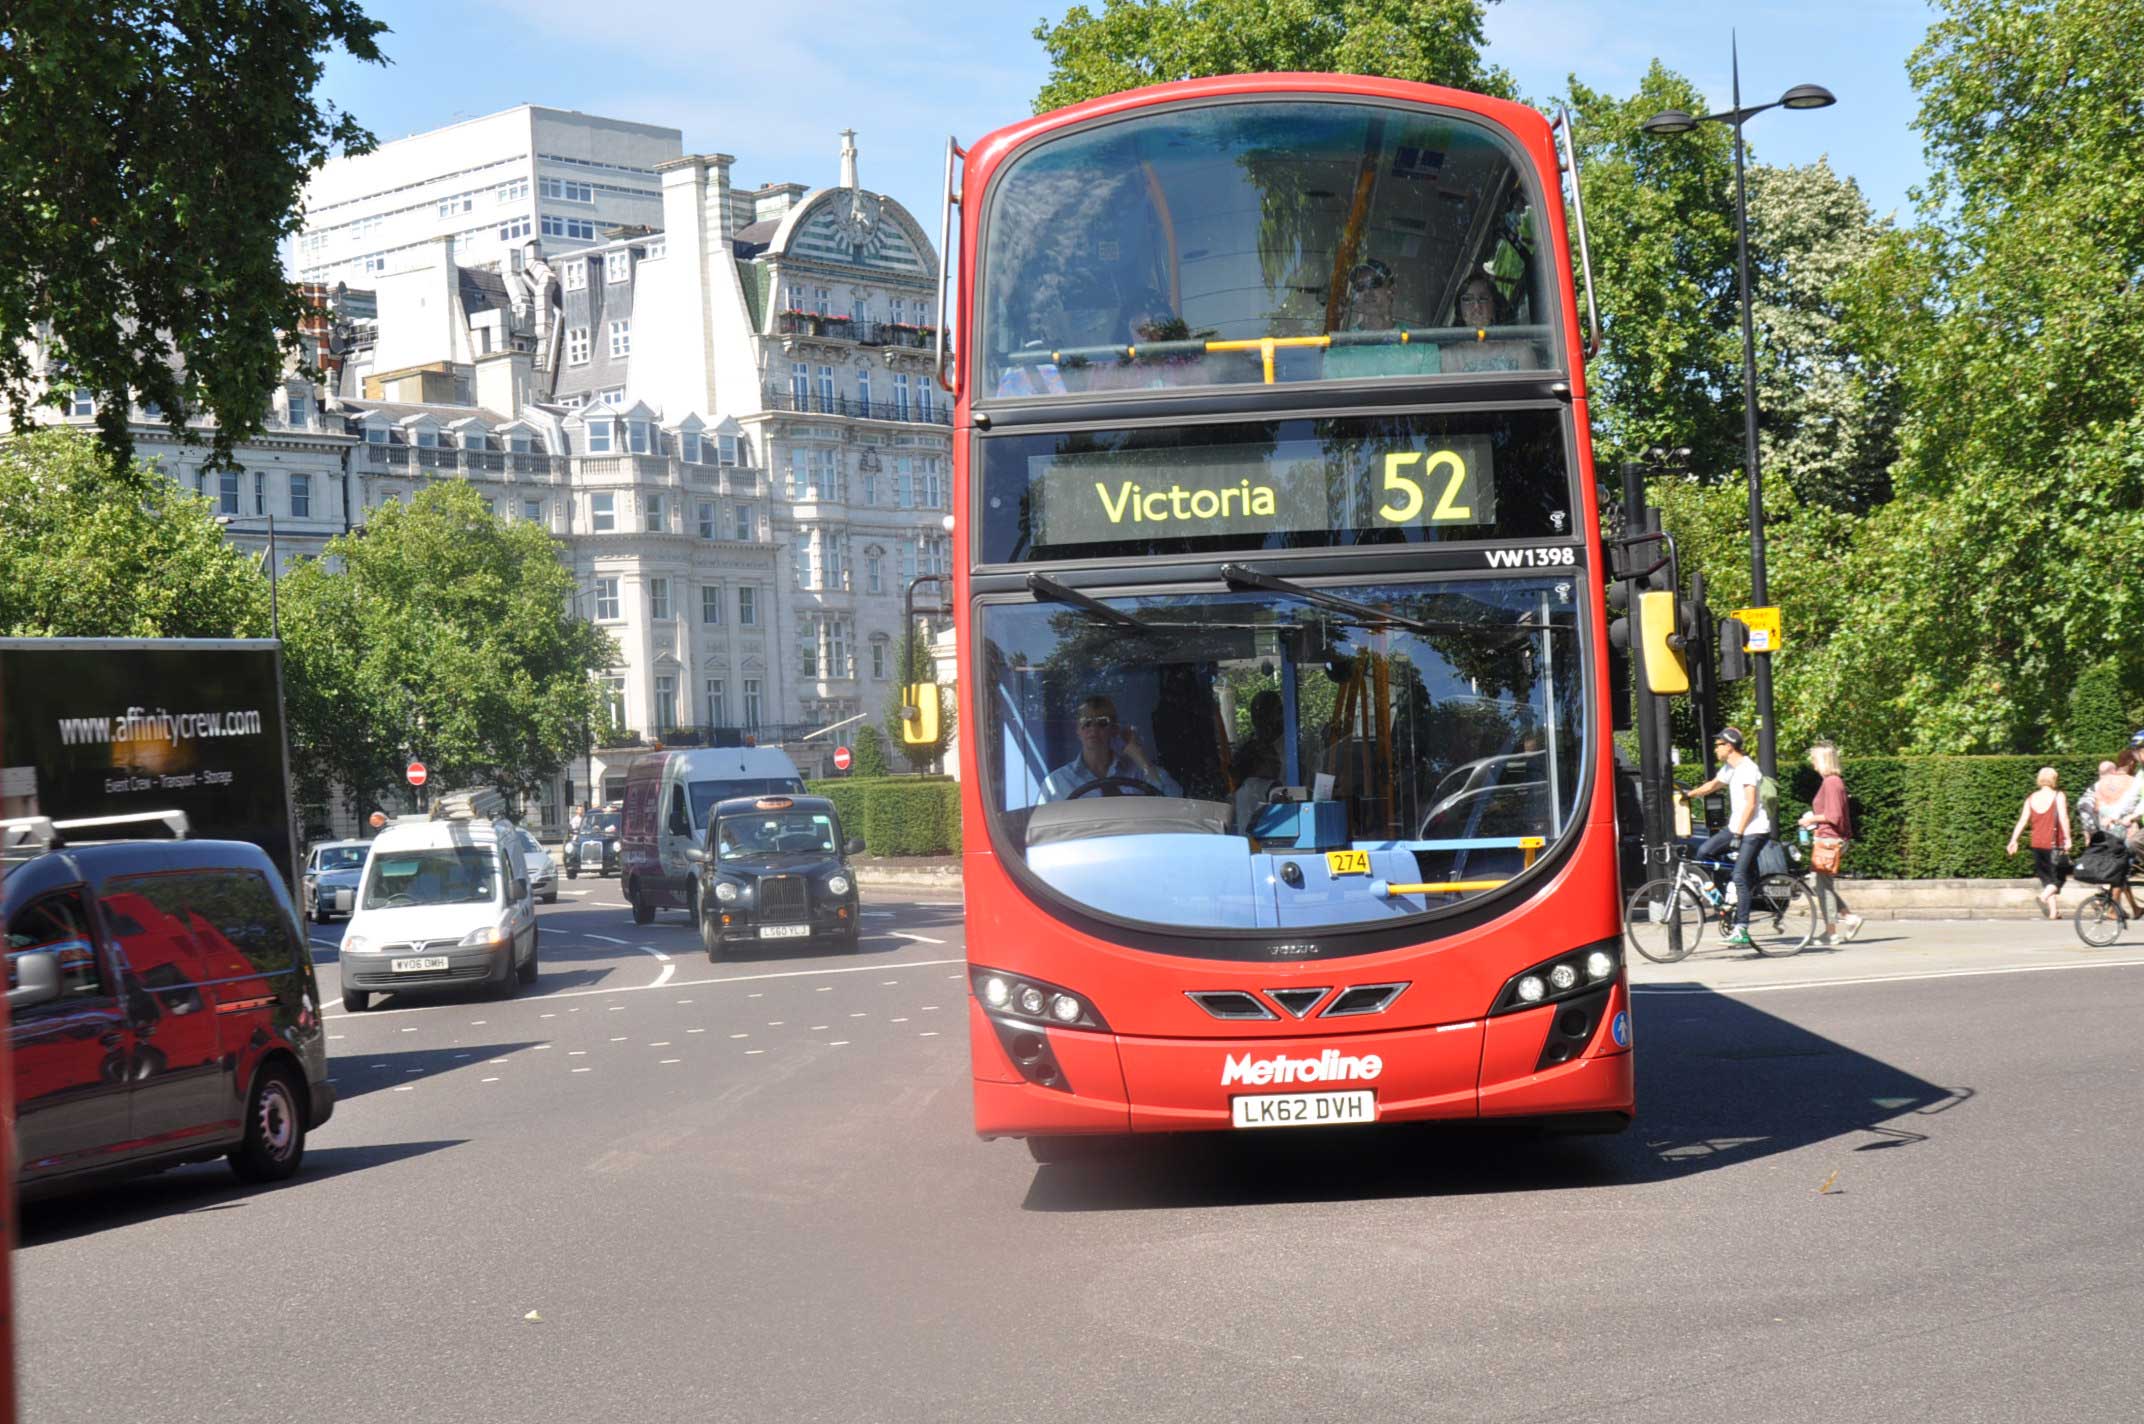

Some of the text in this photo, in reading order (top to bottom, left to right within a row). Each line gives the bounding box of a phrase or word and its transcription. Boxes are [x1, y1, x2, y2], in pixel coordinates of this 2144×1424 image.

[1096, 478, 1275, 523] Victoria
[1379, 451, 1471, 522] 52
[1485, 547, 1575, 568] VW1398
[58, 706, 261, 747] www.affinitycrew.com
[1334, 853, 1366, 871] 274
[1220, 1049, 1383, 1086] Metroline
[1245, 1097, 1362, 1123] LK62 DVH
